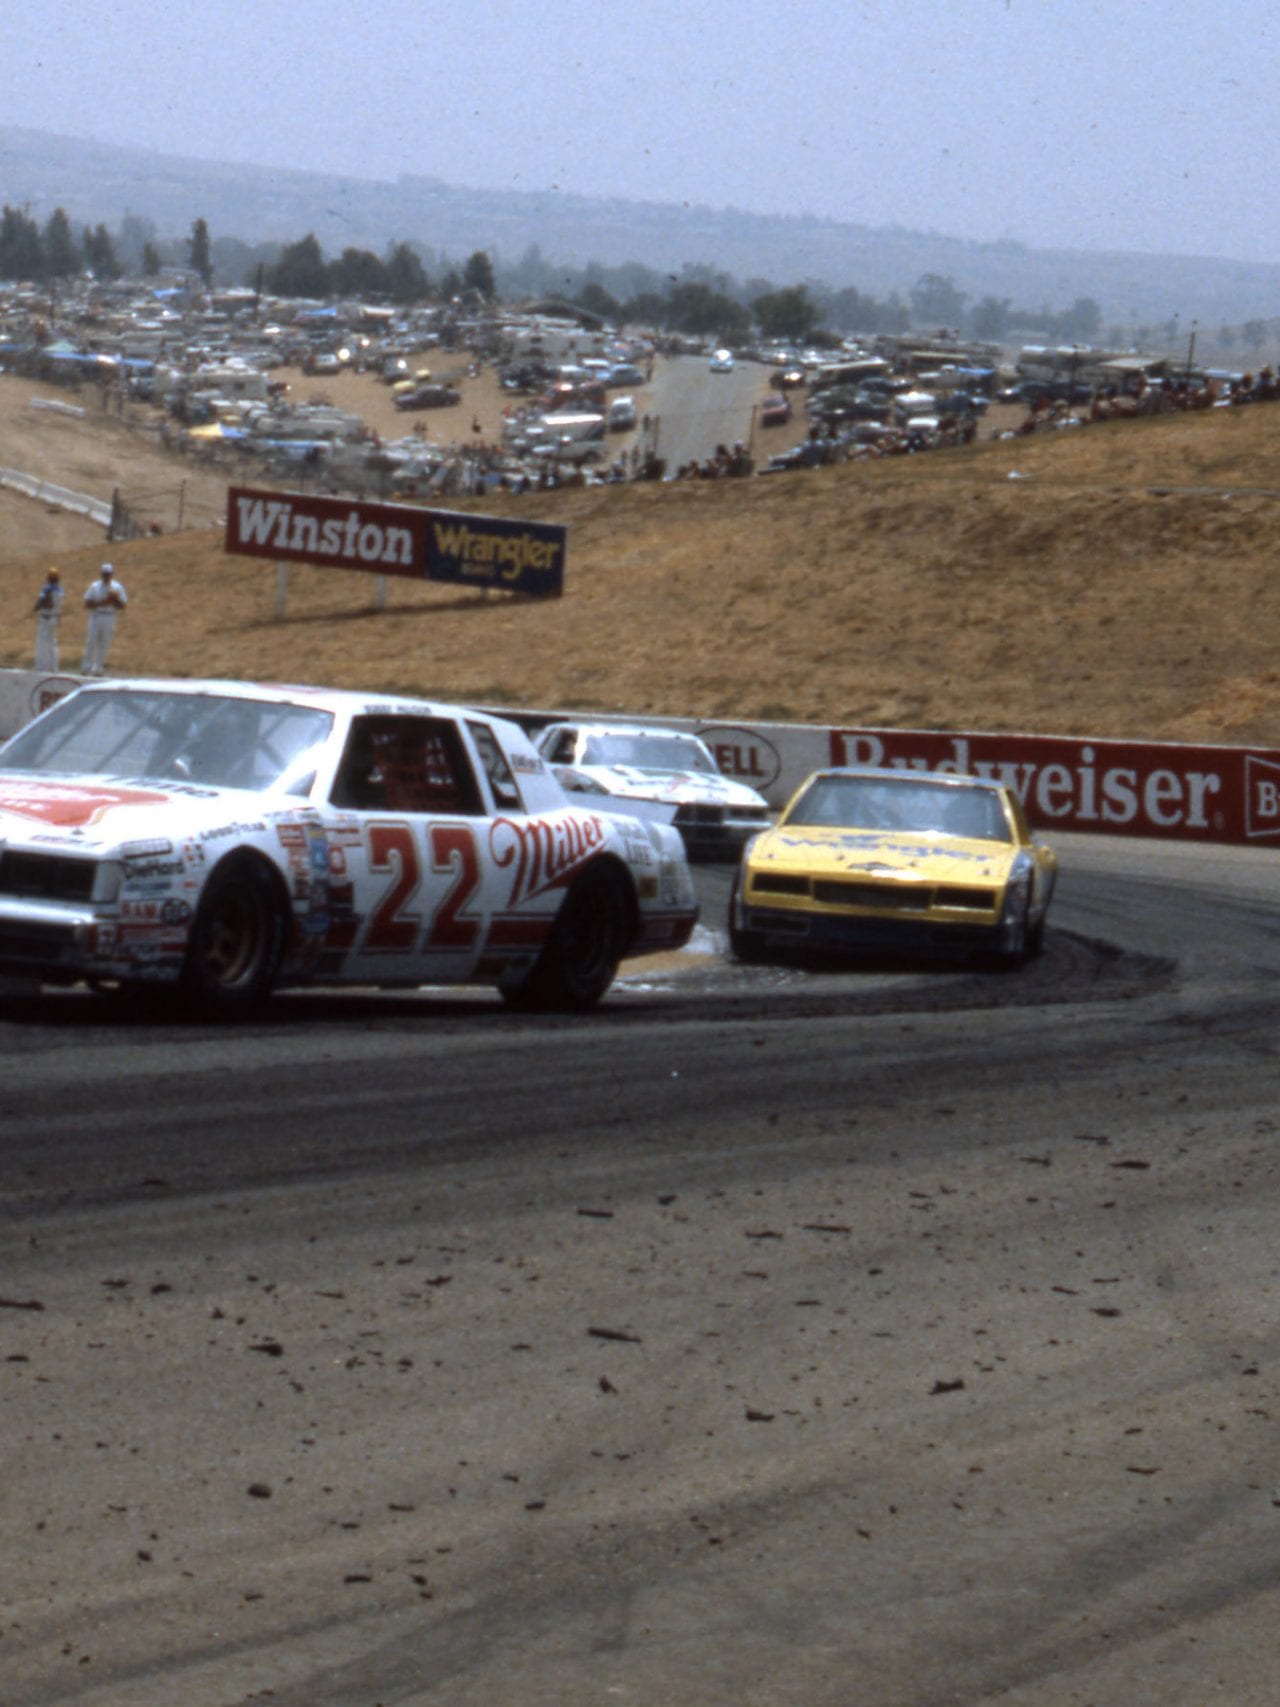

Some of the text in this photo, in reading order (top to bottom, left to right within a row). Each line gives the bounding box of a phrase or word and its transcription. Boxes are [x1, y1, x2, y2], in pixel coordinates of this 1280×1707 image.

[237, 497, 413, 565] Winston
[433, 522, 560, 580] Wrangler
[708, 742, 764, 777] ELL
[841, 734, 1221, 828] Bdweiser
[359, 818, 482, 956] 22
[489, 815, 606, 909] Miller
